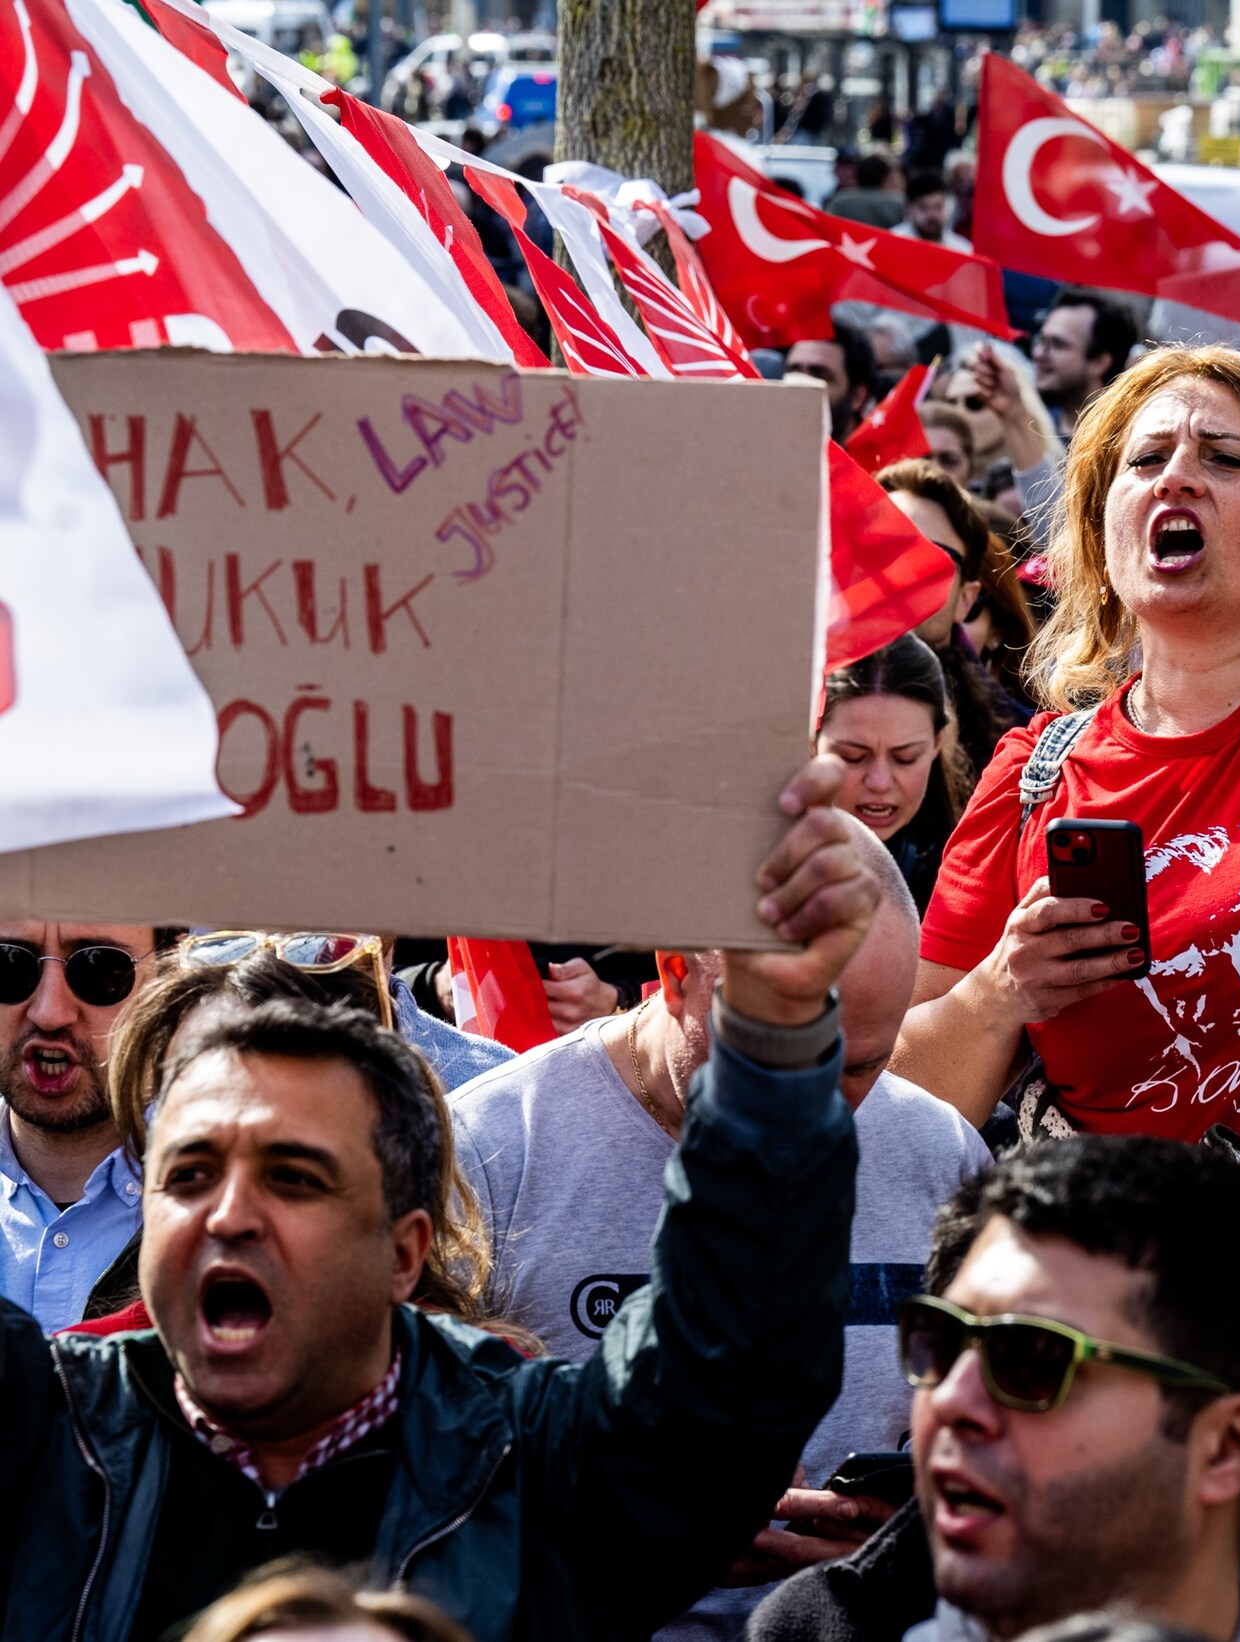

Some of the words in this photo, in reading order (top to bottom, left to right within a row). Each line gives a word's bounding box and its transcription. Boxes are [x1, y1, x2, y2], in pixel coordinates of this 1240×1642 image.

[88, 409, 357, 520] HAK,
[356, 372, 523, 495] LAW
[135, 544, 435, 656] UKUK
[215, 684, 455, 820] OĞLU
